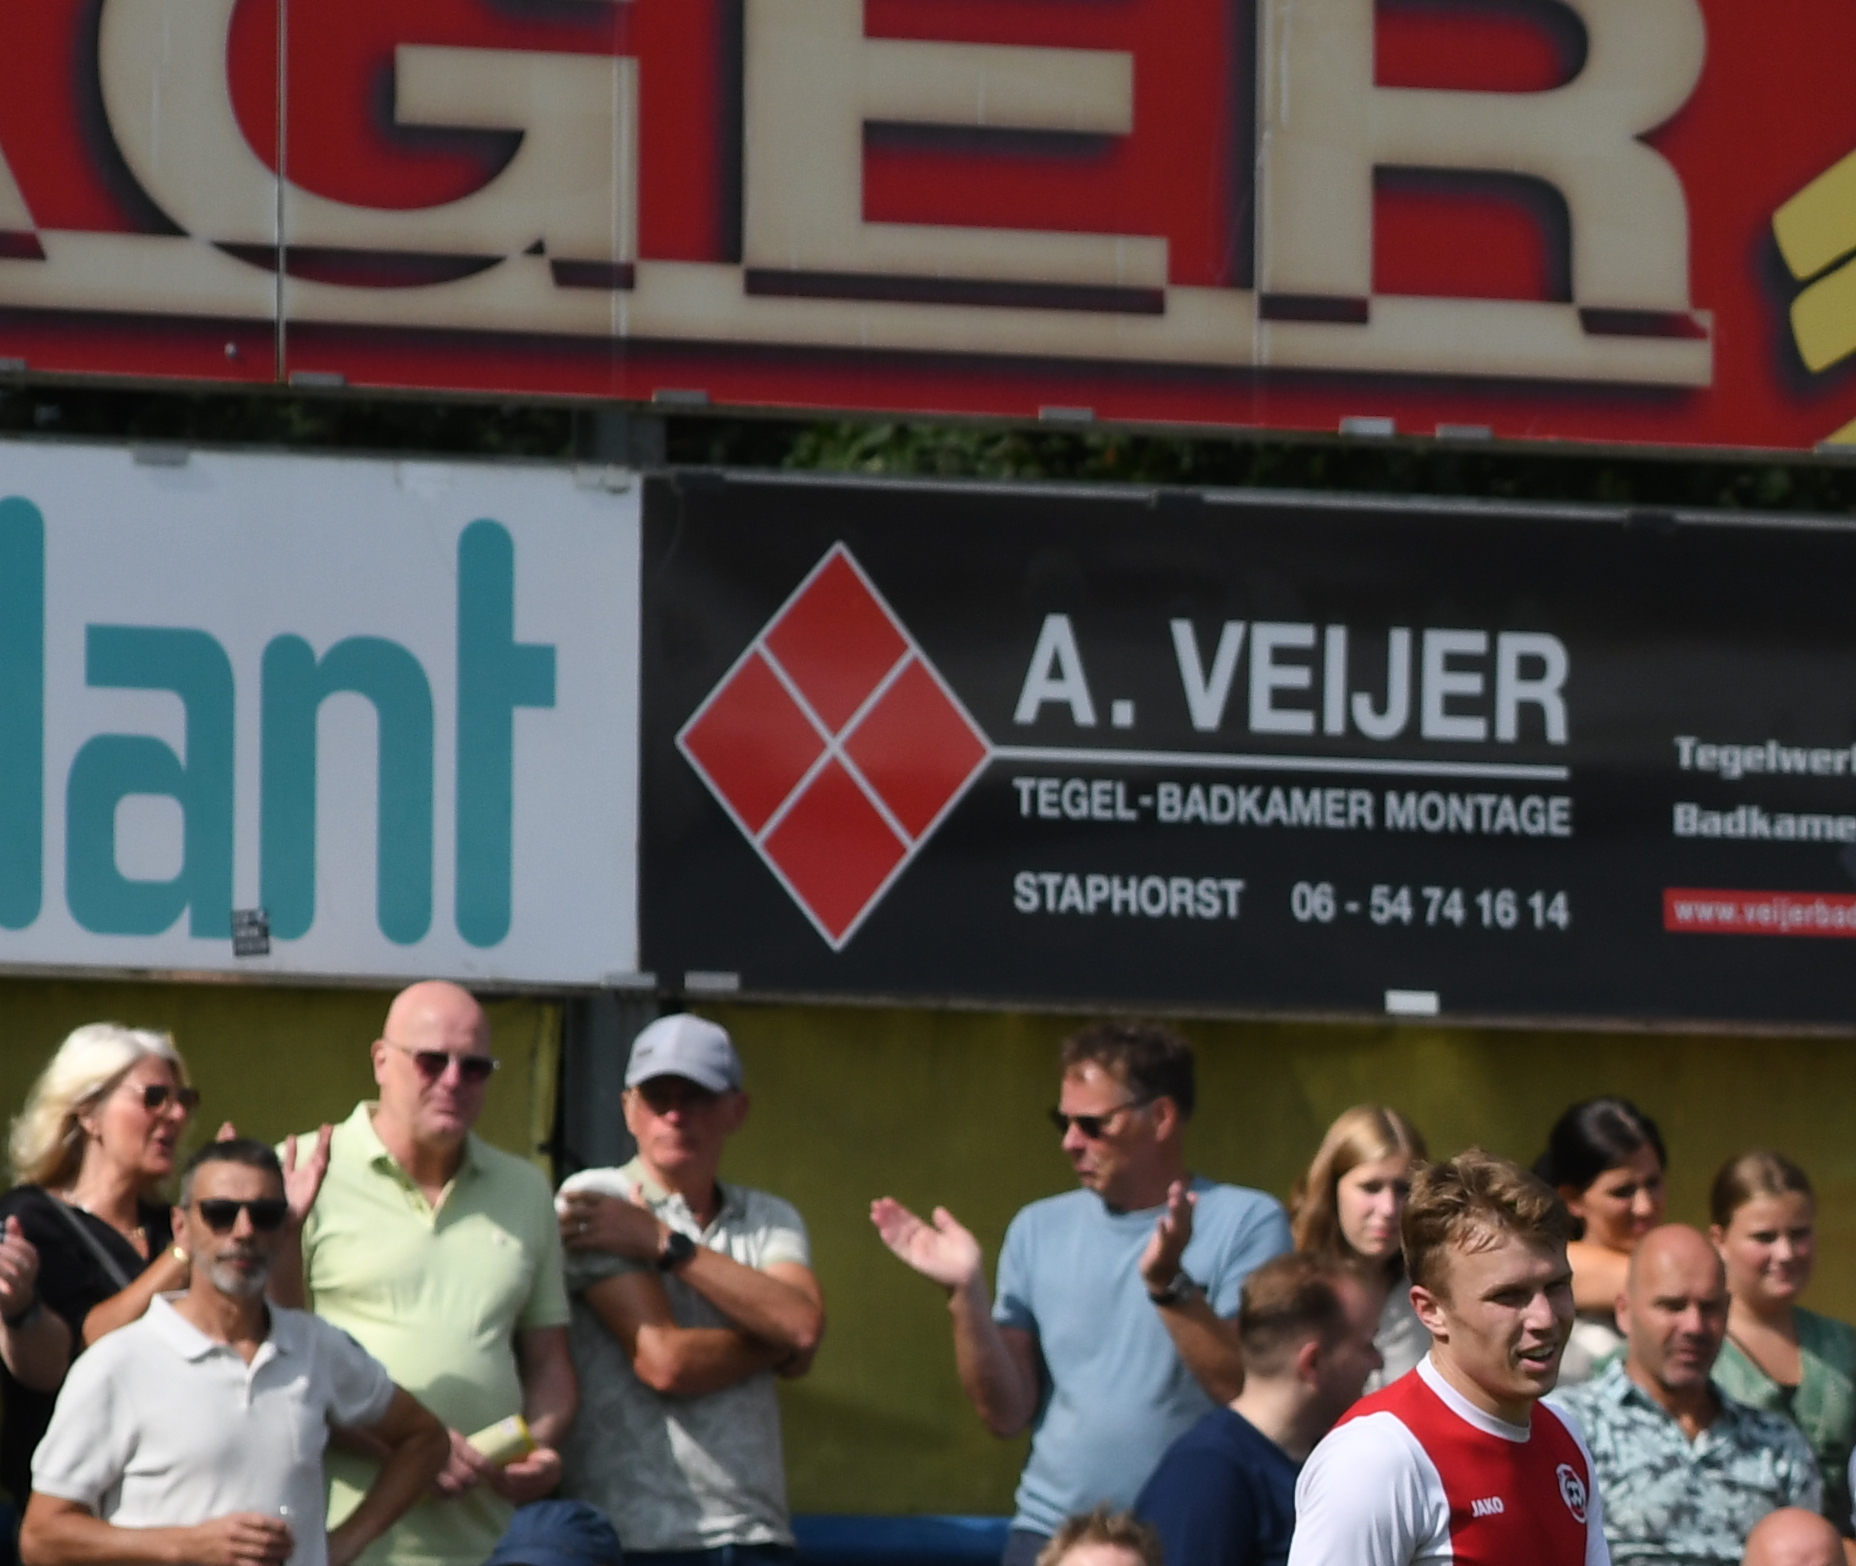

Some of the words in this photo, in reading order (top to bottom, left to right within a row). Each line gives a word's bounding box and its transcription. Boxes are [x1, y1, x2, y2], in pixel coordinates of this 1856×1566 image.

[1013, 613, 1134, 728] A.
[1170, 619, 1569, 745] VEIJER
[1013, 777, 1374, 829] TEGEL-BADKAMER
[1385, 793, 1571, 836] MONTAGE
[1013, 871, 1244, 918] STAPHORST
[1291, 882, 1335, 922] 06
[1370, 885, 1411, 925] 54
[1424, 887, 1465, 926] 74
[1476, 889, 1517, 928] 16
[1529, 891, 1569, 930] 14
[1471, 1496, 1505, 1518] JAKO
